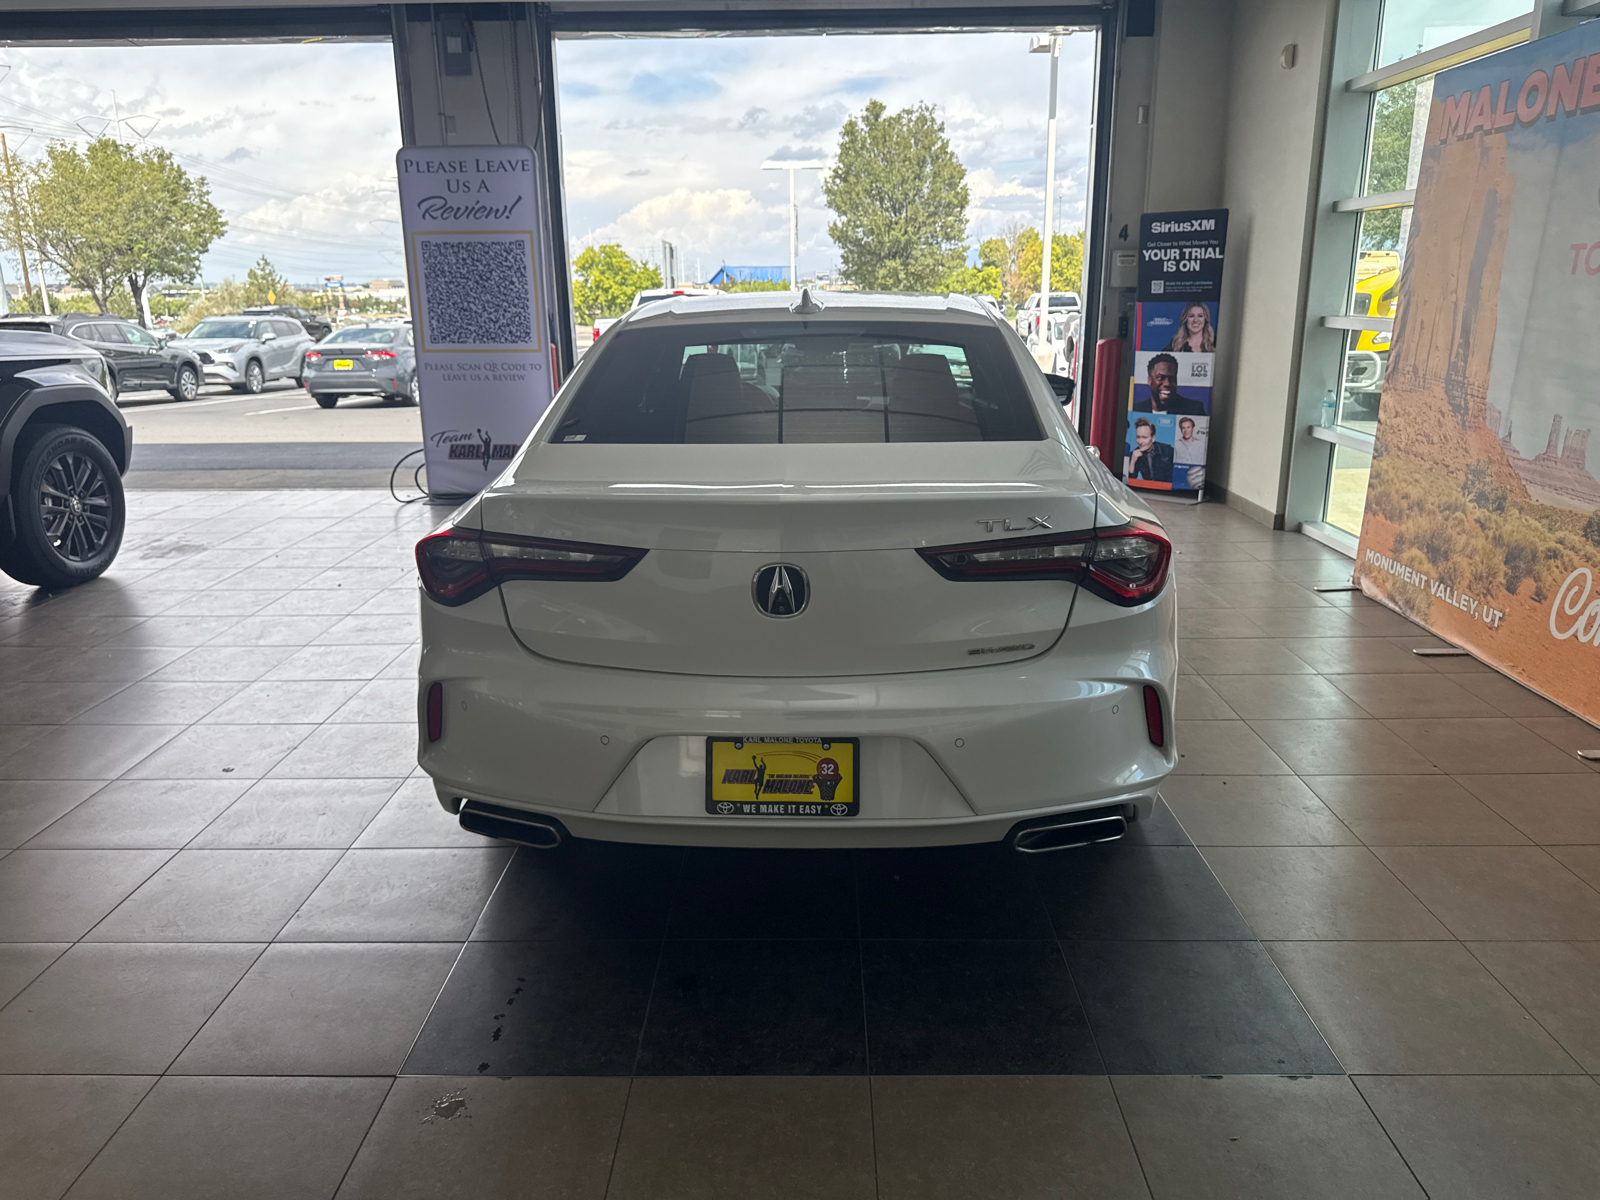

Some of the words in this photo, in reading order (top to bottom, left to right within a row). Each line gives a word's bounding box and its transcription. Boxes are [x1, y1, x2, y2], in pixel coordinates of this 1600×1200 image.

[1438, 53, 1600, 145] MALONE
[477, 179, 491, 193] A
[417, 195, 522, 221] Review!
[1118, 224, 1129, 242] 4
[1151, 219, 1215, 234] SiriusXM
[1142, 249, 1180, 261] YOUR
[1183, 247, 1224, 260] TRIAL
[1163, 260, 1177, 272] IS
[1179, 260, 1200, 272] ON
[424, 362, 454, 371] PLEASE
[457, 362, 481, 371] SCAN
[483, 362, 499, 373] QR
[501, 362, 526, 371] CODE
[1192, 365, 1208, 373] LOL
[430, 429, 475, 448] Team
[449, 444, 483, 460] KARL
[977, 515, 1053, 532] TLX
[1365, 548, 1427, 590] MONUMENT
[1429, 578, 1479, 620] VALLEY,
[1482, 606, 1504, 628] UT
[722, 769, 757, 784] KARL
[821, 763, 834, 775] 32
[762, 779, 815, 794] MALONE
[743, 804, 756, 813] WE
[759, 804, 785, 813] MAKE
[788, 804, 796, 813] IT
[799, 804, 822, 814] EASY
